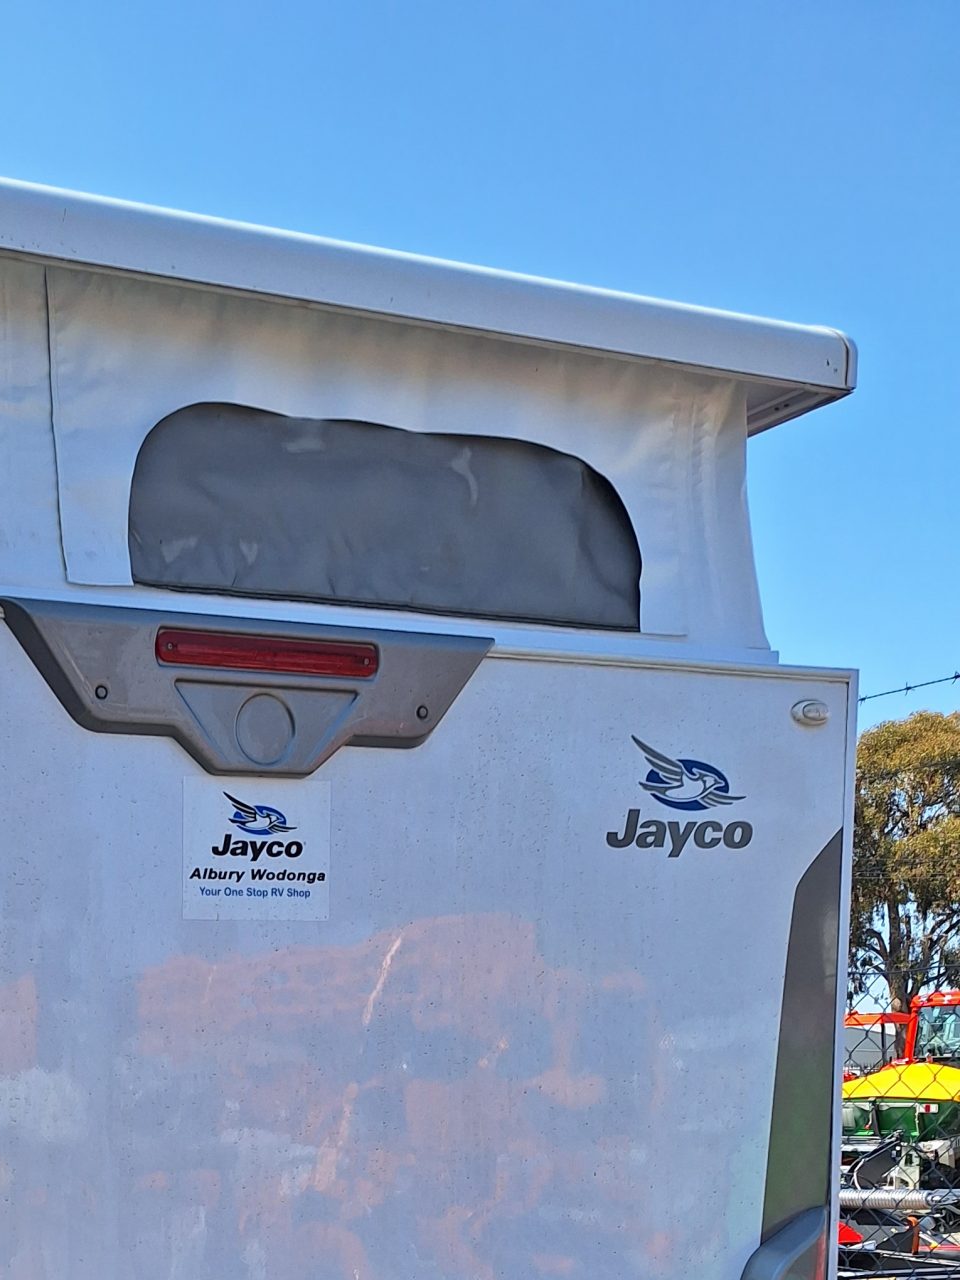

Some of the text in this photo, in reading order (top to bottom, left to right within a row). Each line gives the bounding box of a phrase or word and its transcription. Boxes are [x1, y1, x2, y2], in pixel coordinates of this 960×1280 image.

[605, 808, 753, 858] Jayco
[211, 833, 303, 862] Jayco
[189, 867, 326, 884] Albury Wodonga
[199, 886, 311, 900] Your One Stop RV Shop
